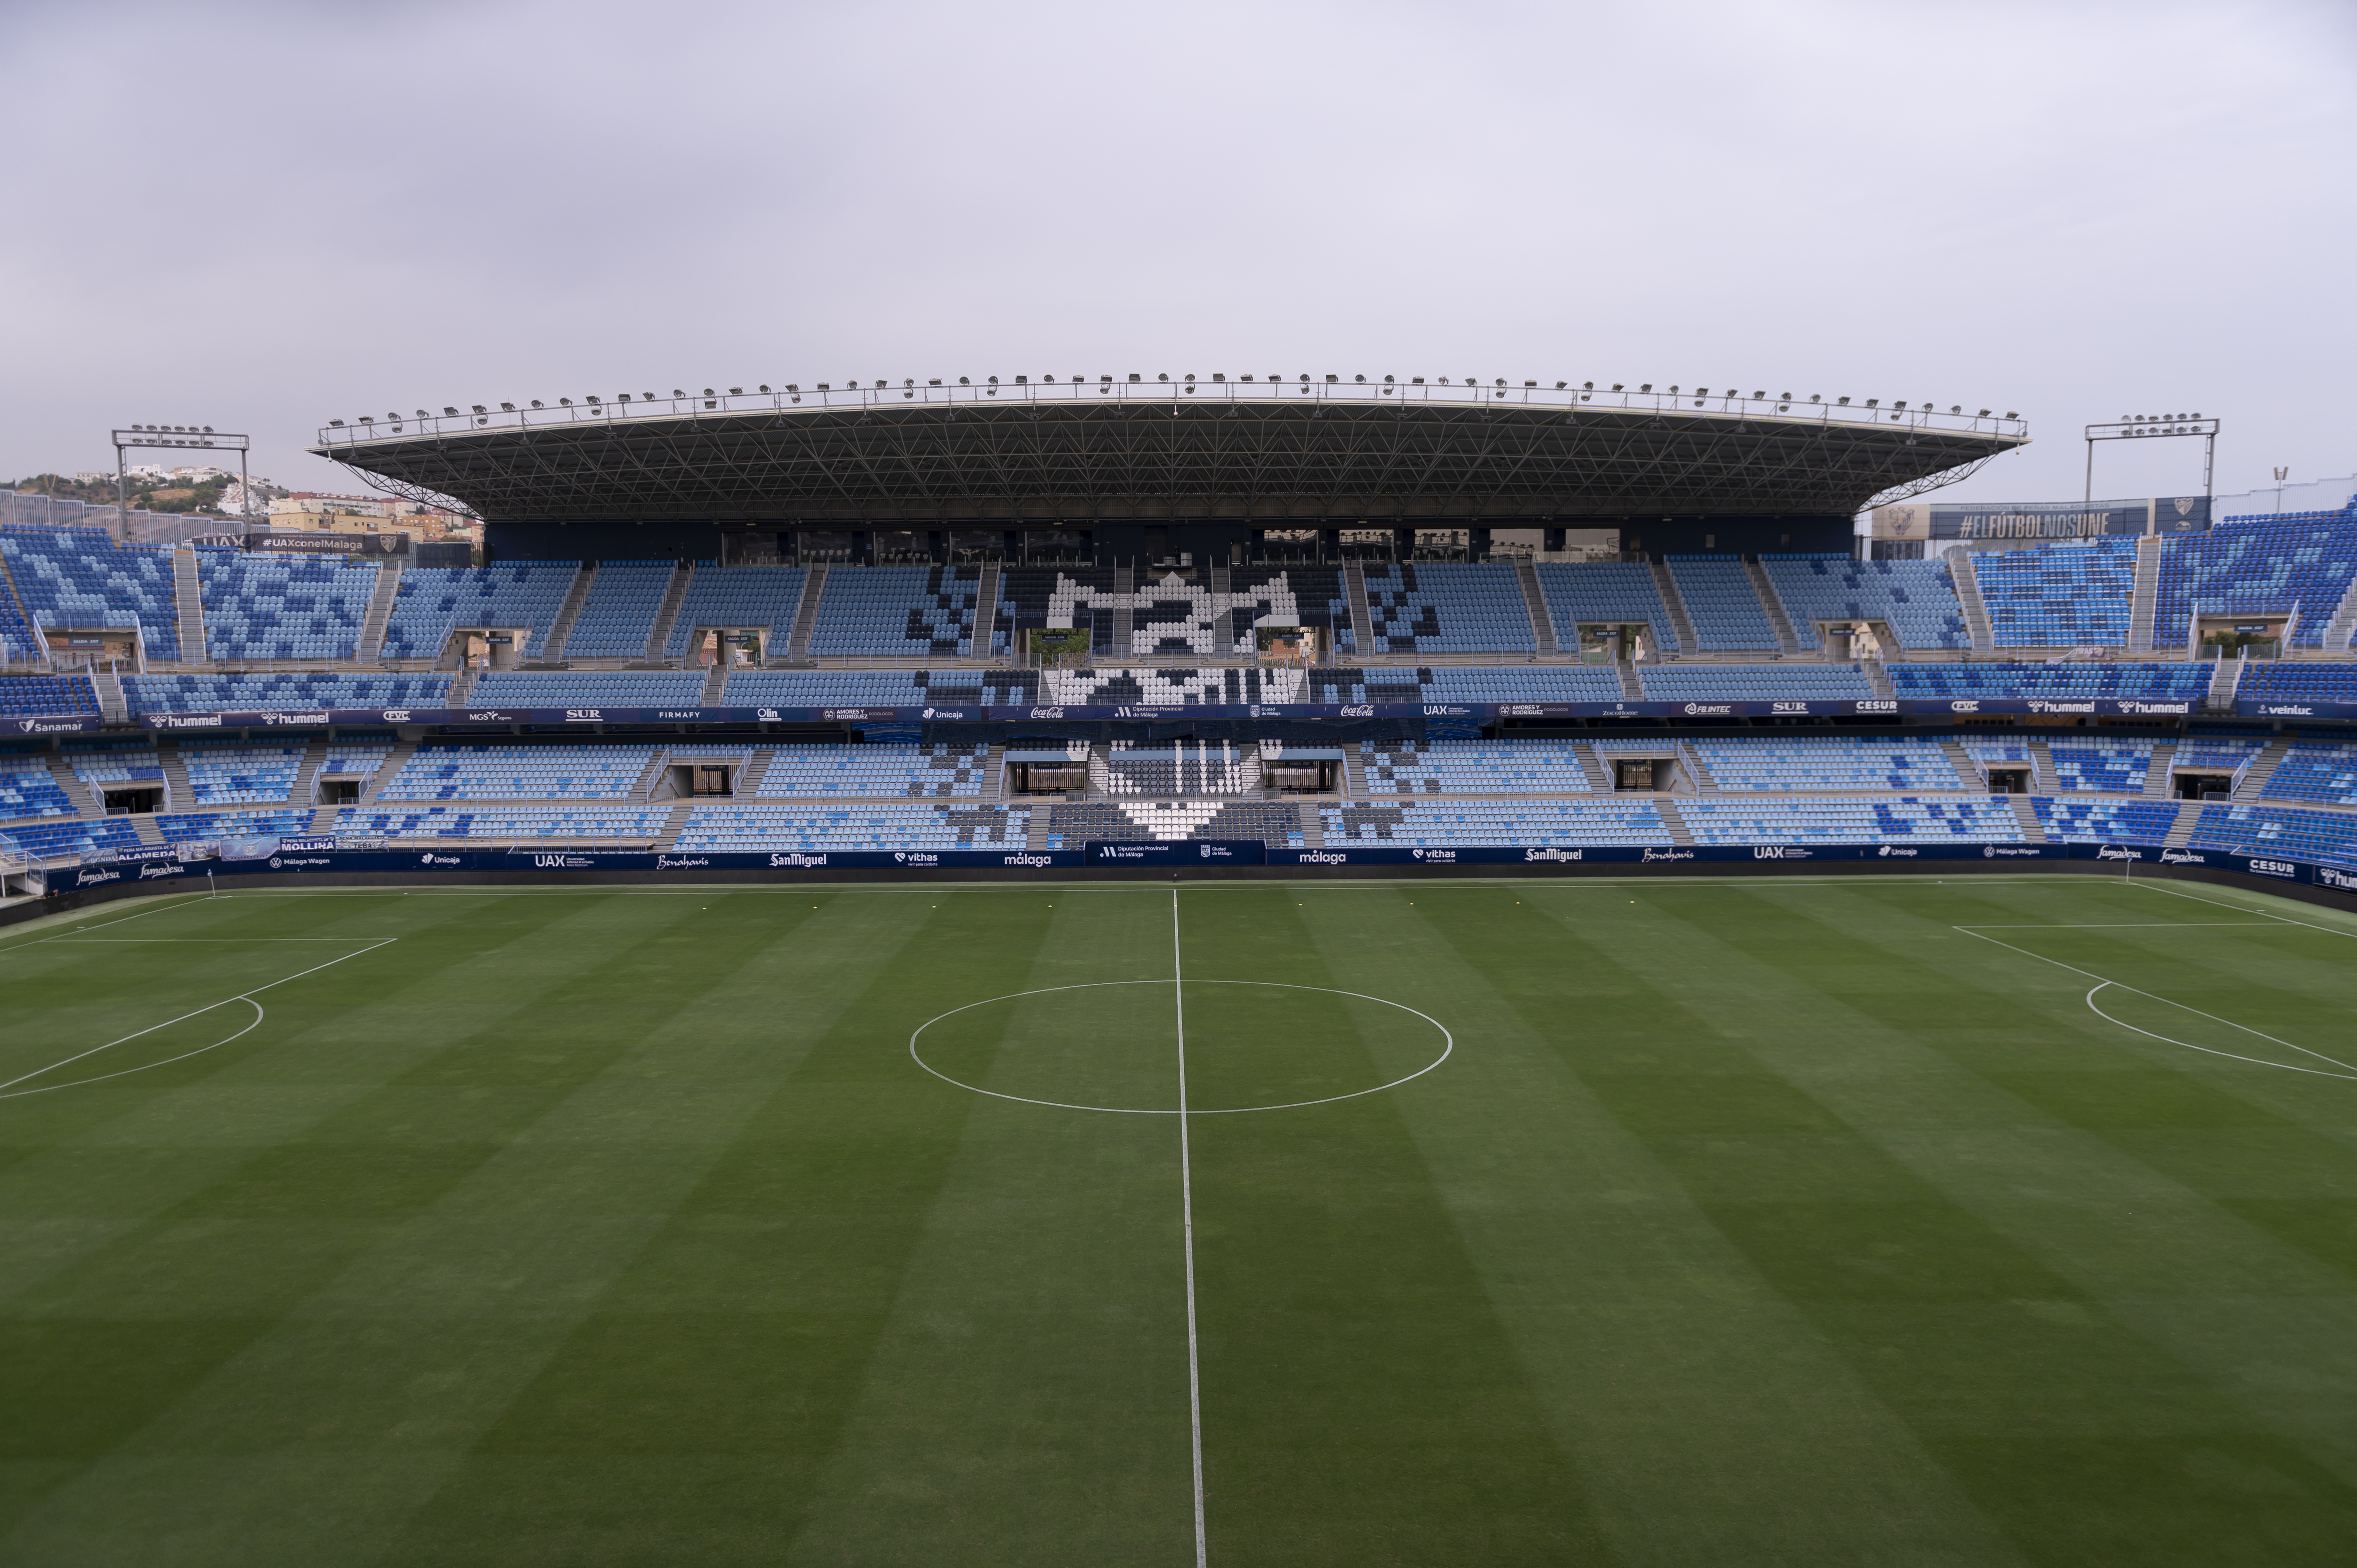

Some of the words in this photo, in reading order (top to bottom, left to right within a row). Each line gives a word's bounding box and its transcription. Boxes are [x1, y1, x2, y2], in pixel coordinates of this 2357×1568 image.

[1341, 705, 1375, 716] Coca-Cola
[1424, 705, 1447, 715] UAX
[1773, 702, 1808, 711] SUR
[1856, 701, 1898, 710] CESUR
[2044, 701, 2095, 713] hummel
[2136, 701, 2189, 713] hummel
[2268, 705, 2313, 715] veinluc
[279, 712, 329, 724] hummel
[758, 708, 778, 718] Olin
[1031, 707, 1064, 718] Coca-Cola
[168, 715, 221, 727] hummel
[35, 723, 82, 732] Sanamar
[281, 842, 335, 851] MOLLINA
[118, 850, 176, 861] ALAMEDA
[907, 853, 938, 861] vithas
[1426, 850, 1456, 858] vithas
[1754, 846, 1785, 859] UAX
[1891, 848, 1917, 857] Unicaja
[2096, 845, 2142, 861] famadesa
[2159, 848, 2206, 864] famadesa
[535, 855, 565, 867] UAX
[2249, 859, 2295, 873] CESUR
[139, 861, 184, 879] famadesa
[76, 868, 120, 886] famadesa
